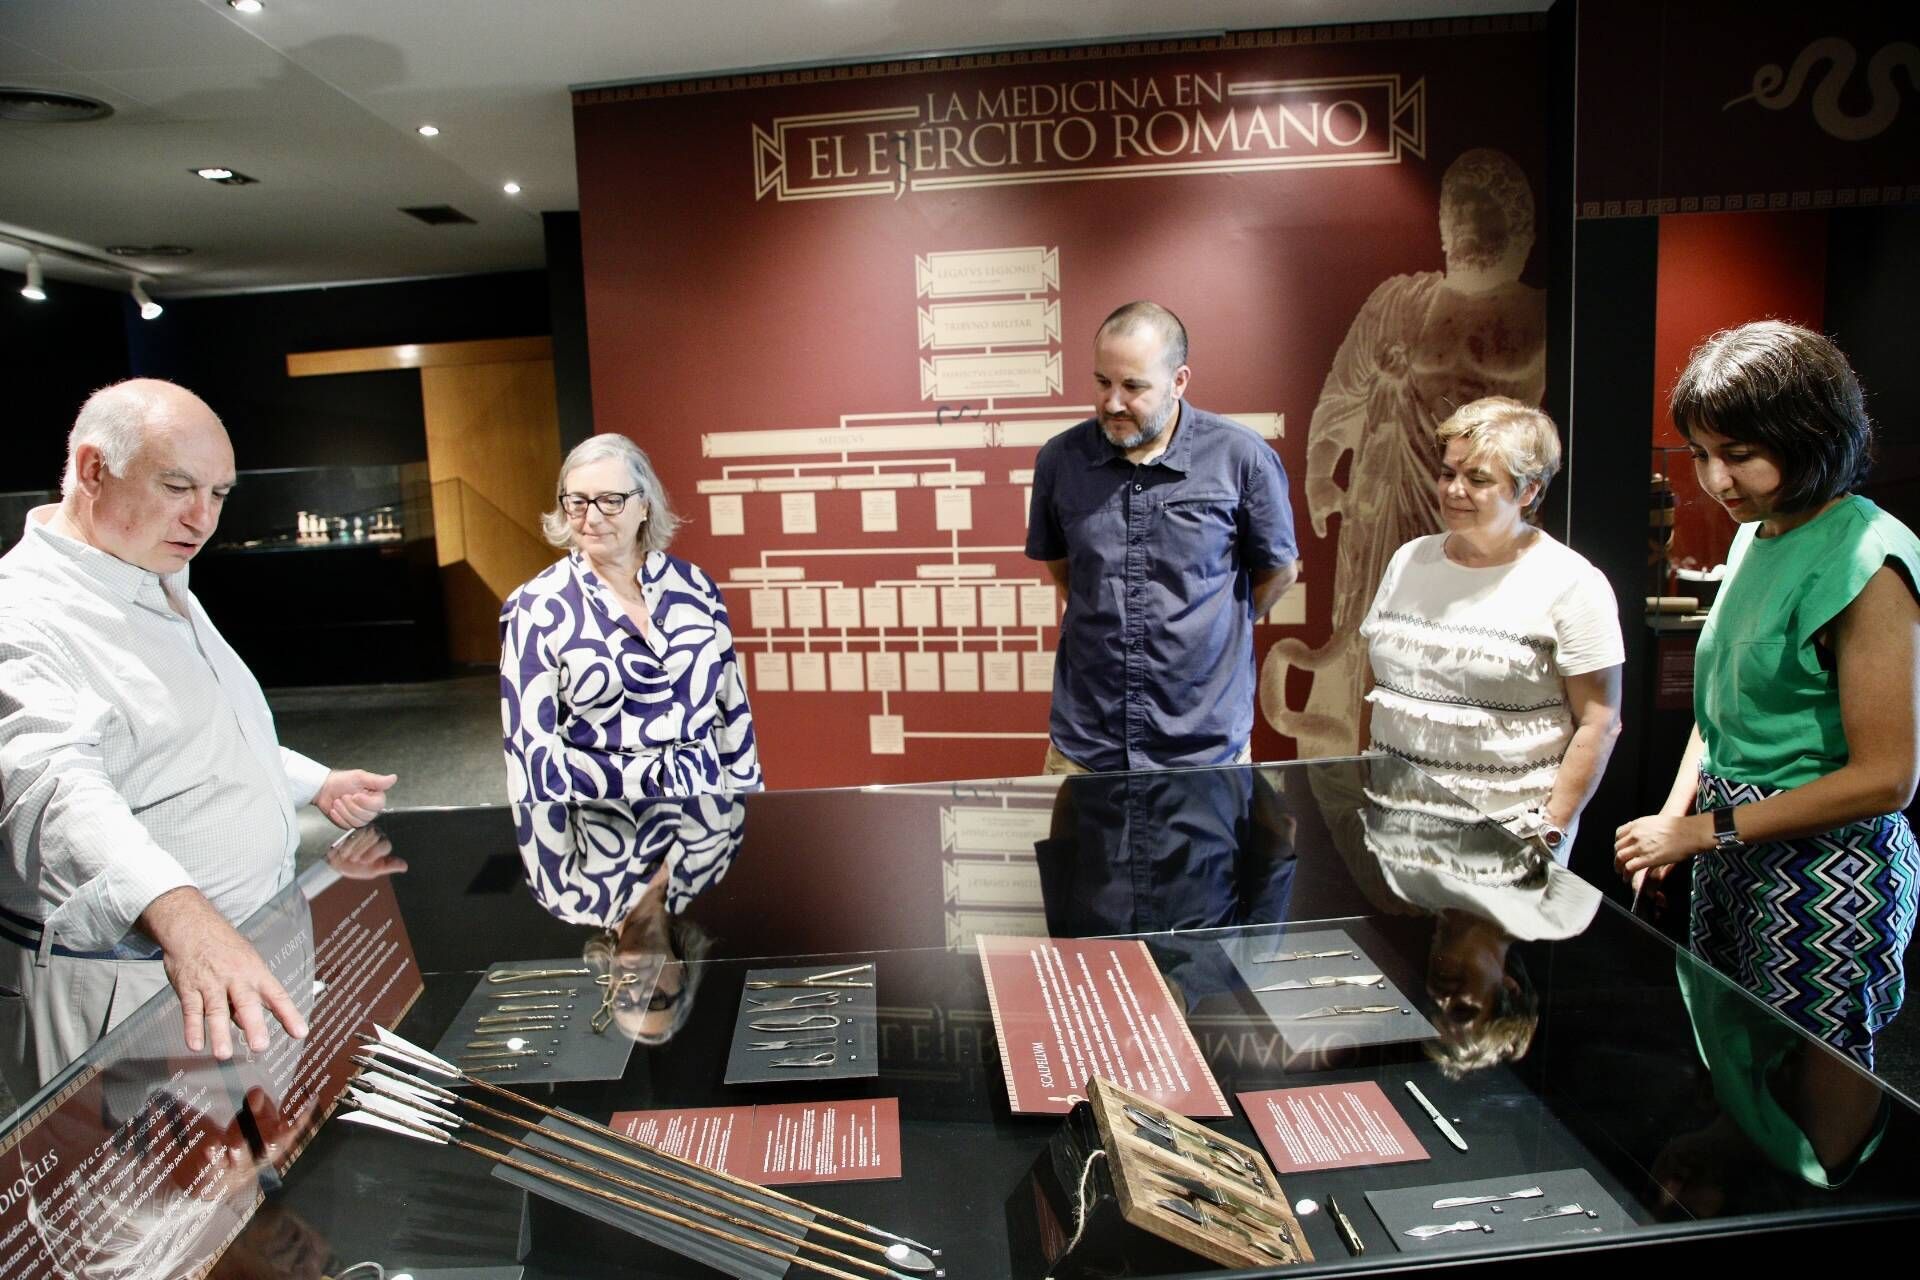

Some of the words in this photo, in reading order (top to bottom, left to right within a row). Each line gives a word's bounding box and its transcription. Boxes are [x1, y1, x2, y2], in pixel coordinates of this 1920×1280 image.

[927, 93, 968, 123] LA
[976, 77, 1166, 120] MEDICINA
[1175, 72, 1223, 106] EN
[808, 135, 858, 180] EL
[867, 117, 1097, 200] EJÉRCITO
[1112, 100, 1368, 158] ROMANO
[1031, 1042, 1055, 1088] SCALPELLVM
[282, 1101, 290, 1114] Las
[0, 1148, 58, 1215] DIOCLES
[0, 1217, 28, 1249] médico
[51, 1181, 63, 1199] del
[62, 1167, 80, 1190] siglo
[79, 1159, 88, 1172] IV
[94, 1146, 101, 1157] C.
[101, 1122, 126, 1150] inventor
[59, 1238, 80, 1265] centro
[81, 1227, 90, 1242] de
[90, 1220, 96, 1232] la
[98, 1199, 119, 1224] misma
[118, 1188, 127, 1202] de
[128, 1181, 135, 1193] un
[135, 1160, 153, 1184] orificio
[154, 1151, 166, 1166] que
[164, 1136, 177, 1153] sirve
[178, 1125, 191, 1142] para
[69, 1215, 78, 1230] de
[102, 1182, 110, 1195] El
[109, 1148, 143, 1188] instrumento
[144, 1134, 158, 1153] tiene
[157, 1118, 173, 1139] forma
[75, 1258, 84, 1273] sin
[112, 1212, 125, 1232] más
[126, 1204, 133, 1216] el
[132, 1188, 147, 1210] daño
[147, 1160, 175, 1195] producido
[175, 1151, 185, 1167] por
[182, 1144, 188, 1155] la
[187, 1127, 204, 1148] flecha.
[183, 1182, 195, 1199] que
[200, 1178, 214, 1199] Filipo
[216, 1166, 224, 1178] de
[28, 1233, 36, 1247] la
